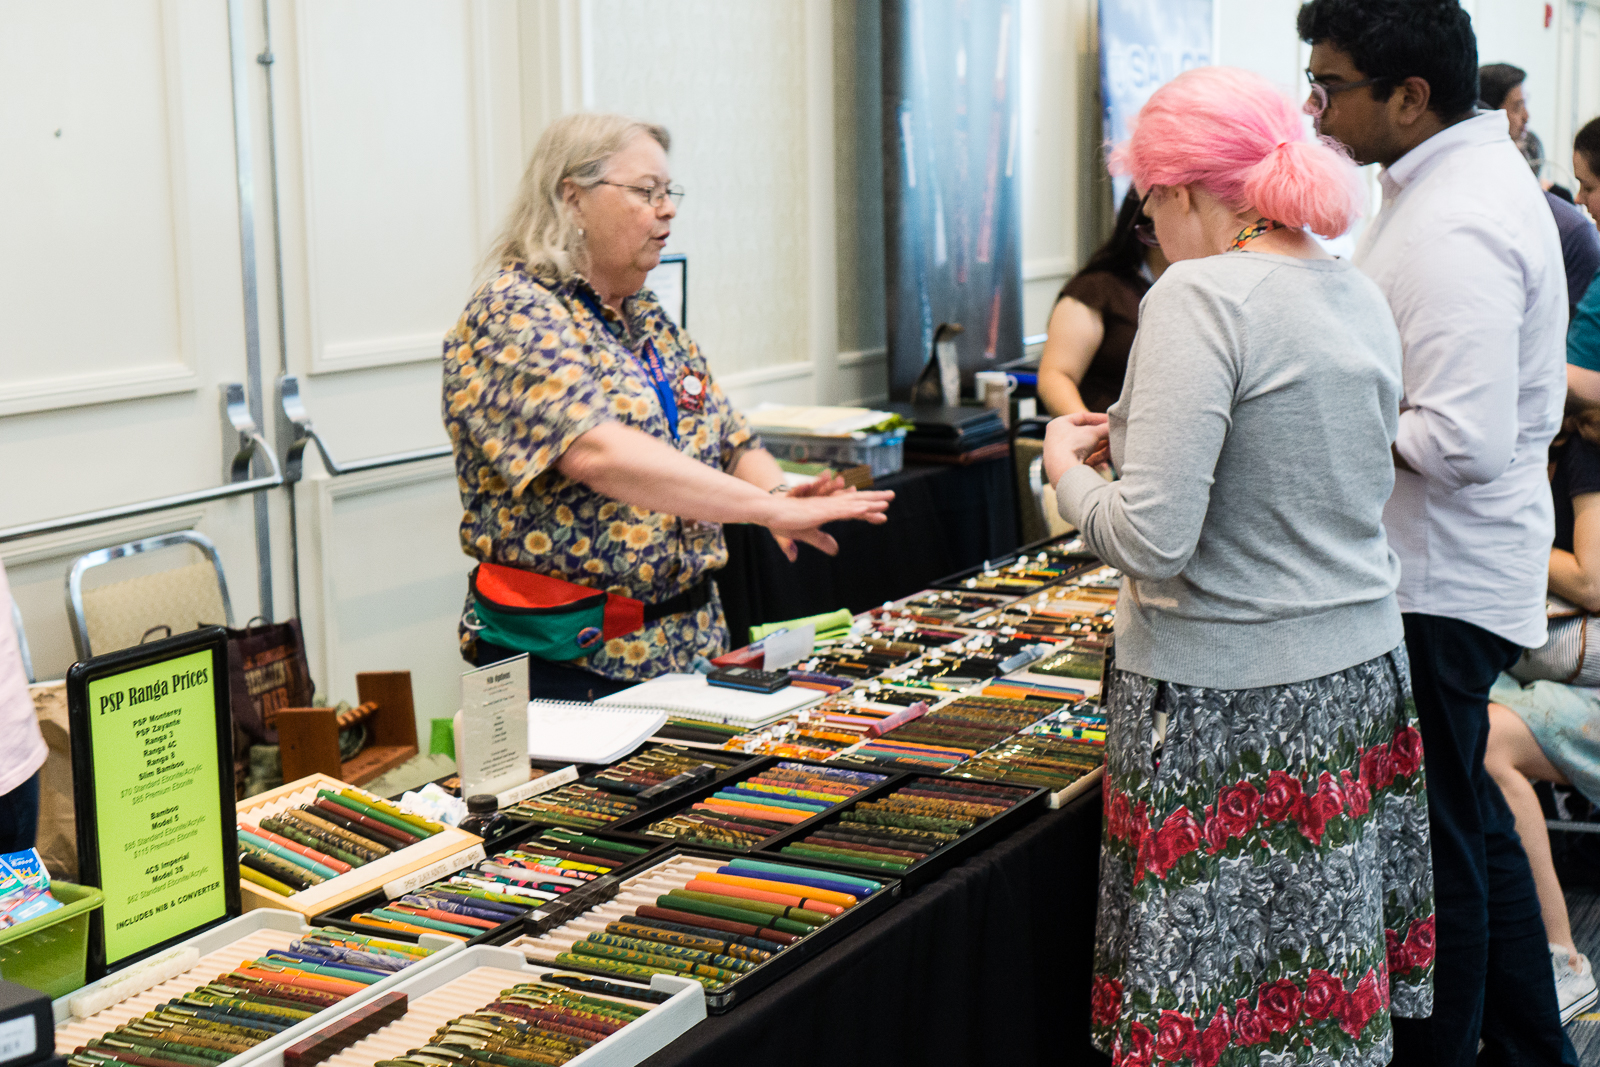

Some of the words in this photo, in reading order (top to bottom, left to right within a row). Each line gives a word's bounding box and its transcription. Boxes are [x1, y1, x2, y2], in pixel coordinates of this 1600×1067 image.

[100, 691, 124, 715] PSP
[128, 679, 169, 707] Ranga
[172, 668, 209, 693] Prices
[133, 717, 147, 728] PSP
[149, 707, 182, 723] Monterey
[136, 727, 150, 738] PSP
[152, 719, 181, 733] Zayante
[145, 734, 168, 746] Ranga
[169, 730, 174, 738] 3
[143, 745, 166, 757] Ranga
[167, 740, 177, 749] 4C
[146, 755, 169, 767] Ranga
[138, 771, 155, 781] Slim
[156, 760, 185, 775] Bamboo
[150, 805, 179, 820] Bamboo
[151, 816, 173, 830] Model
[161, 852, 190, 869] Imperial
[152, 869, 173, 884] Model
[116, 909, 154, 931] INCLUDES
[155, 903, 169, 914] NIB
[177, 881, 220, 904] CONVERTER
